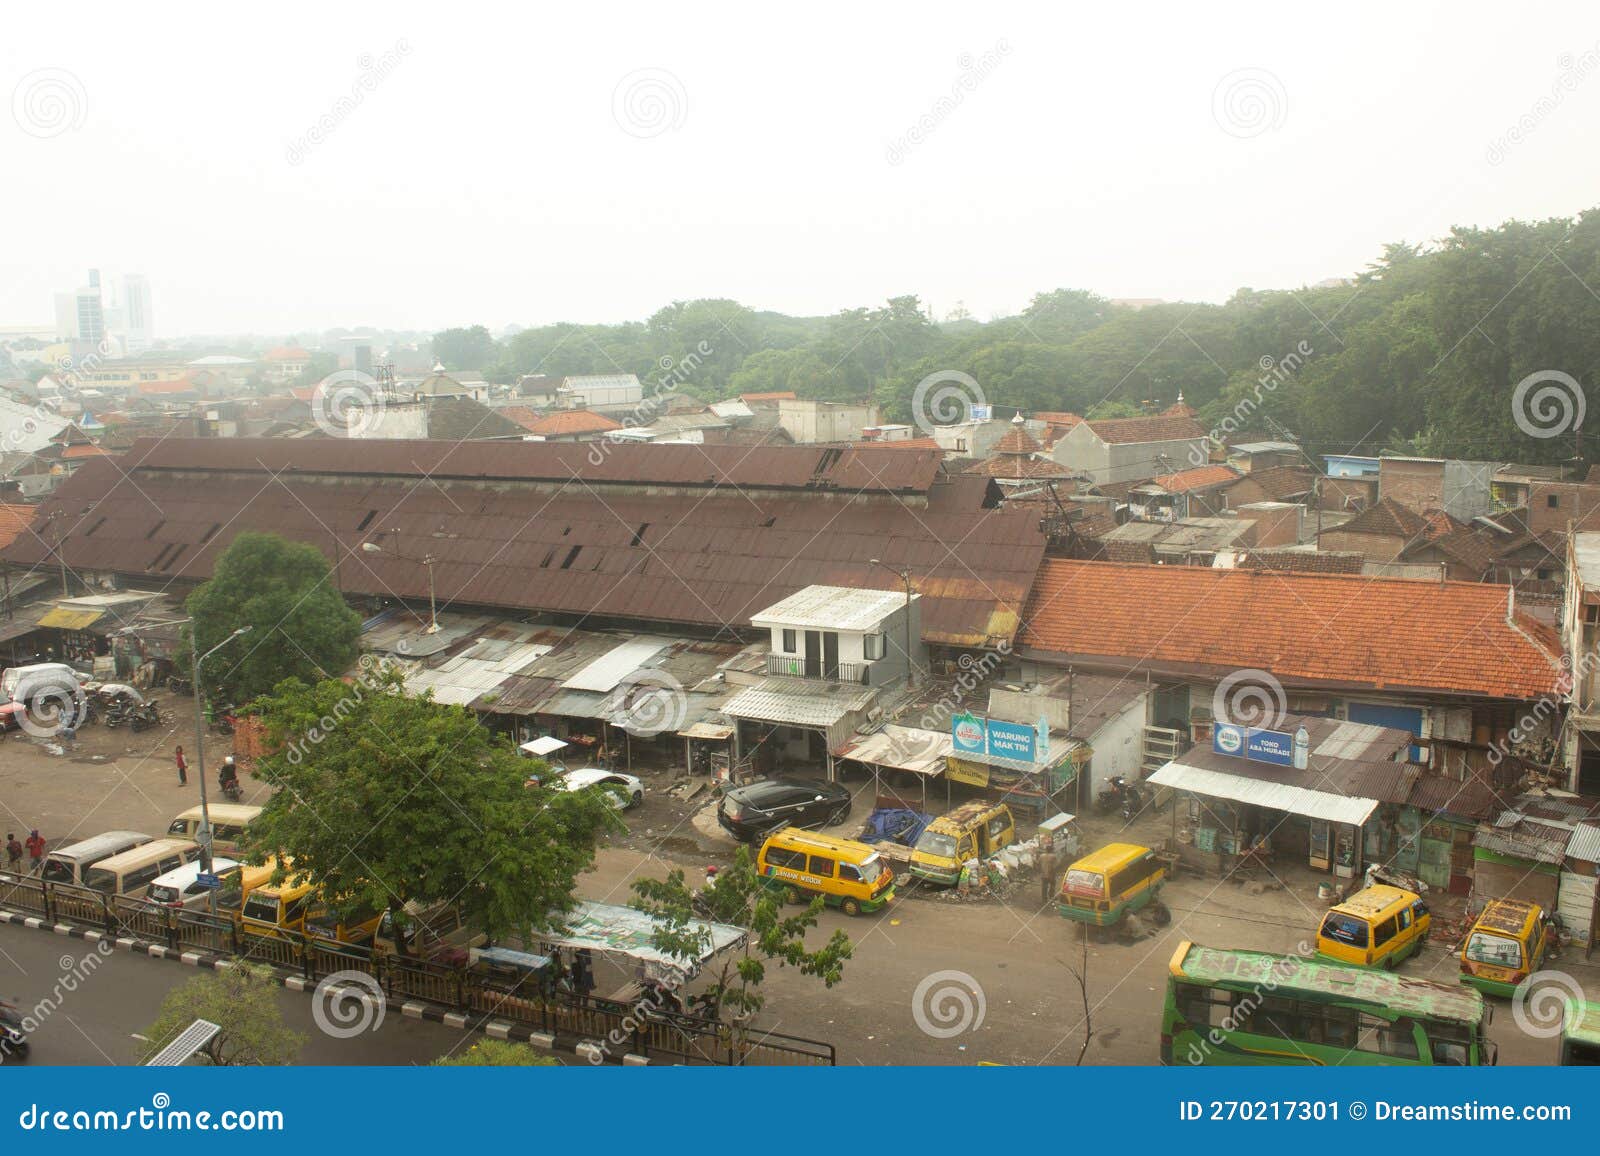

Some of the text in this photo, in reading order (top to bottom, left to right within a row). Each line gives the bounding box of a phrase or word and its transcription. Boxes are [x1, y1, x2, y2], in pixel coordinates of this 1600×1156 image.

[992, 730, 1031, 743] WARUNG
[994, 740, 1029, 752] MAK TIN
[1261, 740, 1280, 748] TOKO
